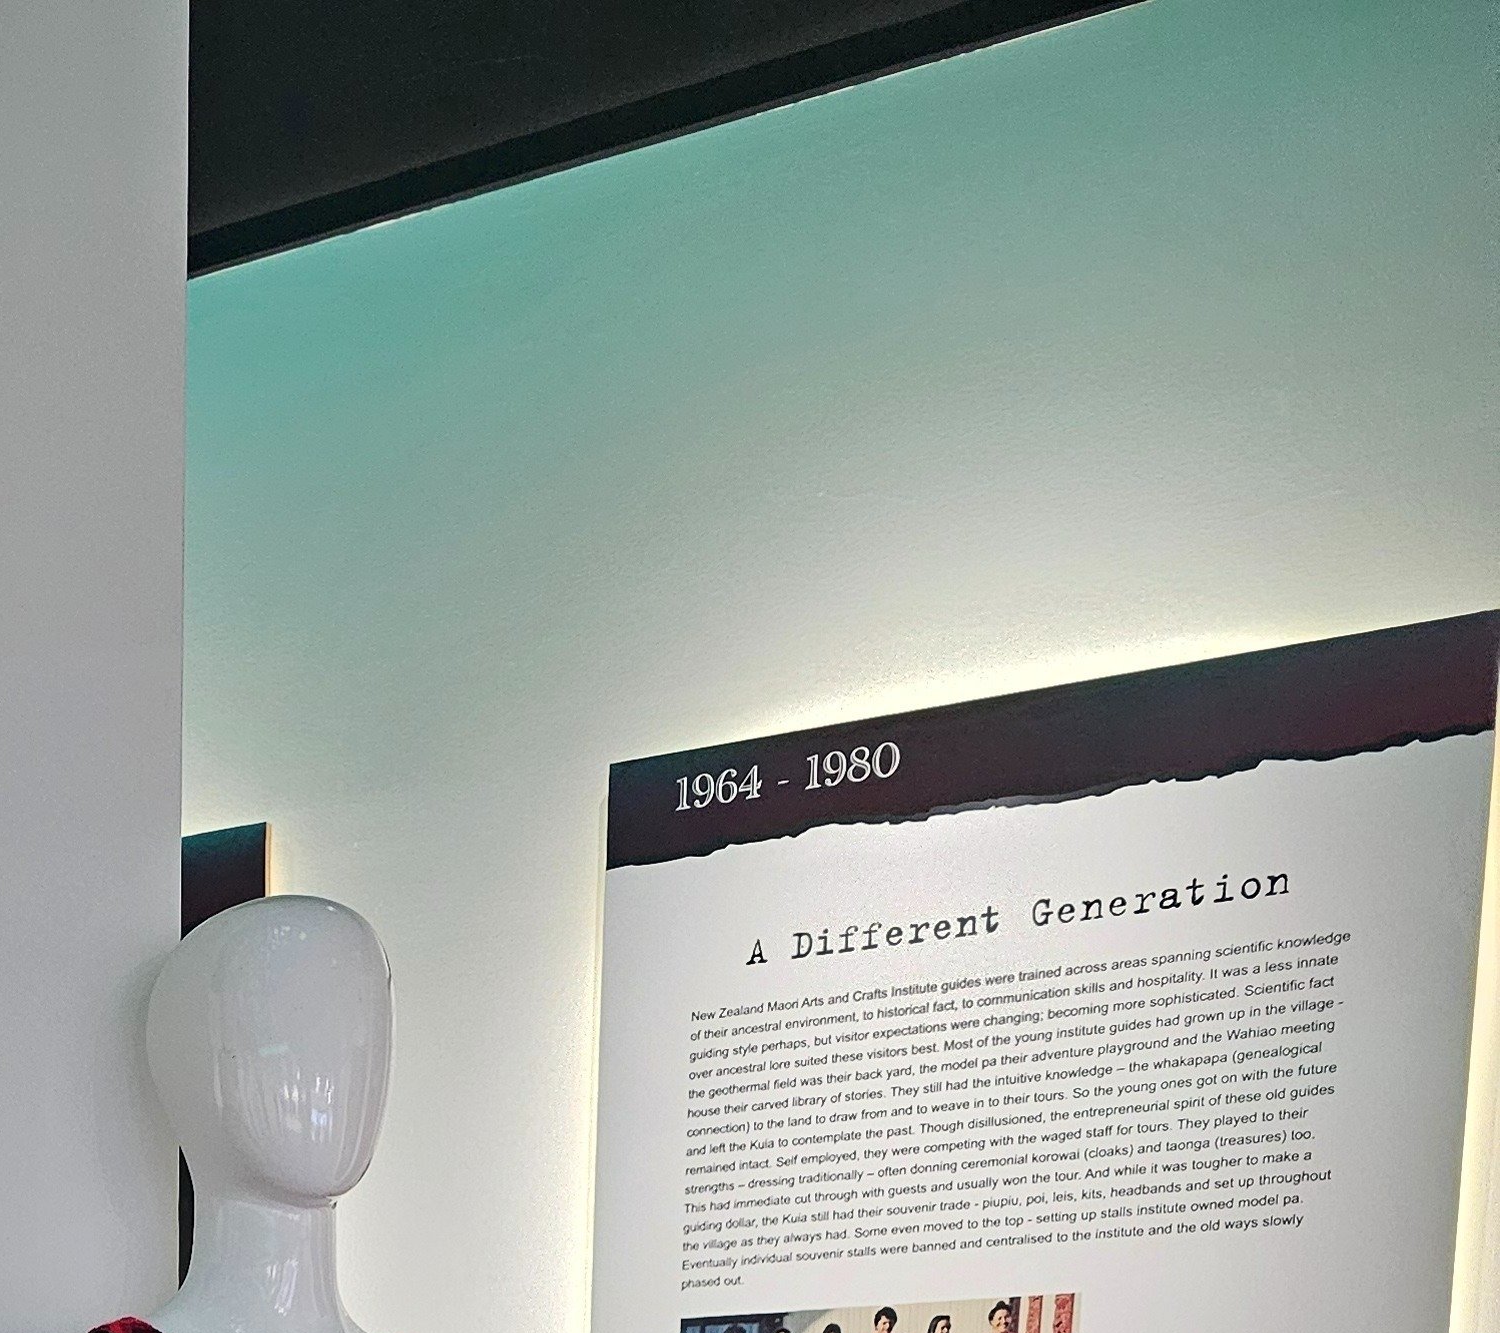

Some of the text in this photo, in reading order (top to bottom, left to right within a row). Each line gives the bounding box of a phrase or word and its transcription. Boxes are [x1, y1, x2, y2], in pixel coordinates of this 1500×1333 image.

[674, 764, 762, 812] 1964
[804, 740, 900, 790] 1980
[746, 870, 1290, 966] A Different Generation
[689, 975, 1334, 1063] guiding style perhaps, but visitor expectations were changing; becoming more sophisticated. Scientific fact
[690, 954, 1338, 1041] of their ancestral environment, to historical fact, to communication skills and hospitality. It was a less innate
[691, 931, 1351, 1021] New Zealand Maori Arts and Crafts Institute guides were trained across areas spanning scientific knowledge
[688, 1068, 713, 1080] over
[715, 1060, 766, 1076] ancestral
[769, 1060, 790, 1070] lore
[794, 1053, 828, 1068] suited
[831, 1052, 863, 1063] these
[866, 1047, 908, 1059] visitors
[911, 1042, 939, 1055] best.
[943, 1038, 973, 1051] Most
[976, 1035, 989, 1048] of
[991, 1034, 1011, 1046] the
[1014, 1031, 1053, 1046] young
[1056, 1024, 1105, 1038] institute
[1108, 1018, 1151, 1035] guides
[1155, 1013, 1180, 1027] had
[1183, 1011, 1224, 1027] grown
[1228, 1009, 1245, 1021] up
[1249, 1005, 1261, 1017] in
[1265, 1003, 1286, 1015] the
[1290, 999, 1334, 1012] village
[680, 1271, 744, 1291] phased out.
